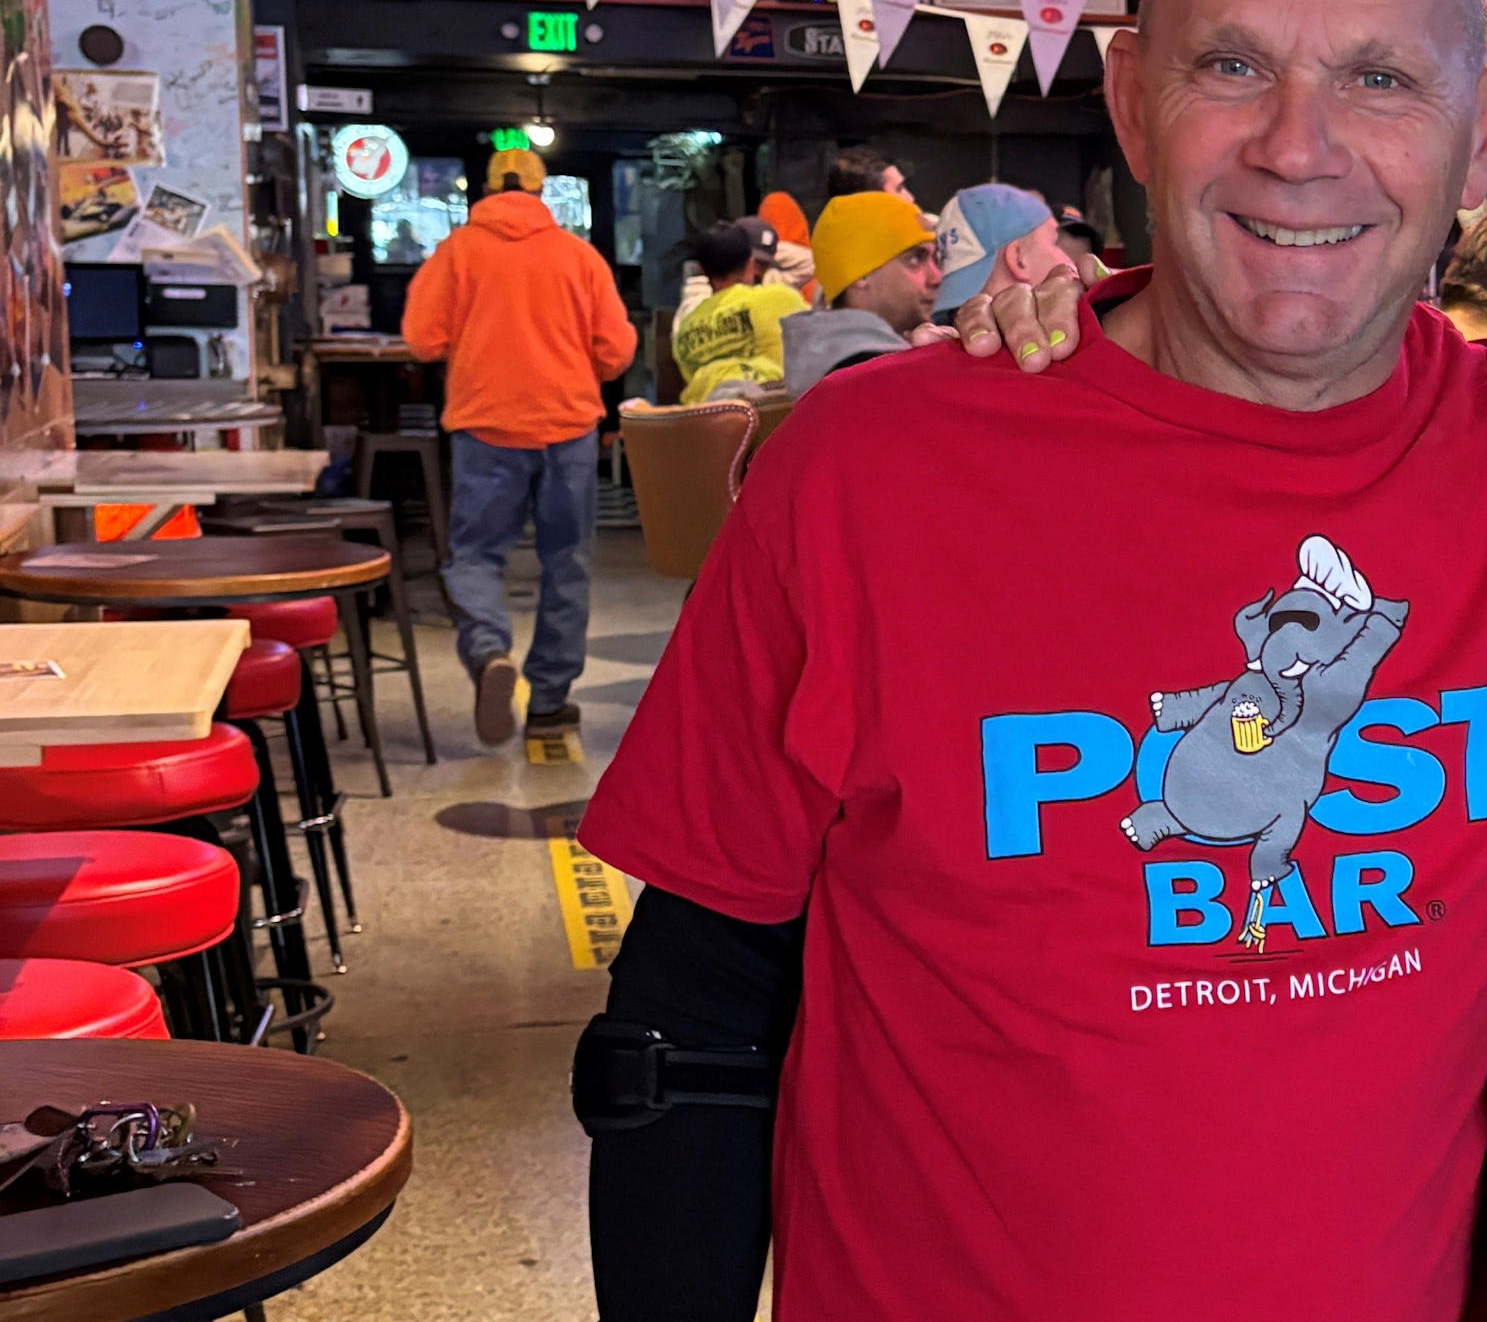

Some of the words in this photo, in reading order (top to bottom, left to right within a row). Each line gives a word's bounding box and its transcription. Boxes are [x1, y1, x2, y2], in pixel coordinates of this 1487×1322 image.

[528, 11, 578, 52] EXIT
[805, 27, 844, 56] STA
[1142, 848, 1424, 949] BAR
[1130, 978, 1276, 1013] DETROIT,
[1289, 947, 1422, 1001] MICHIGAN
